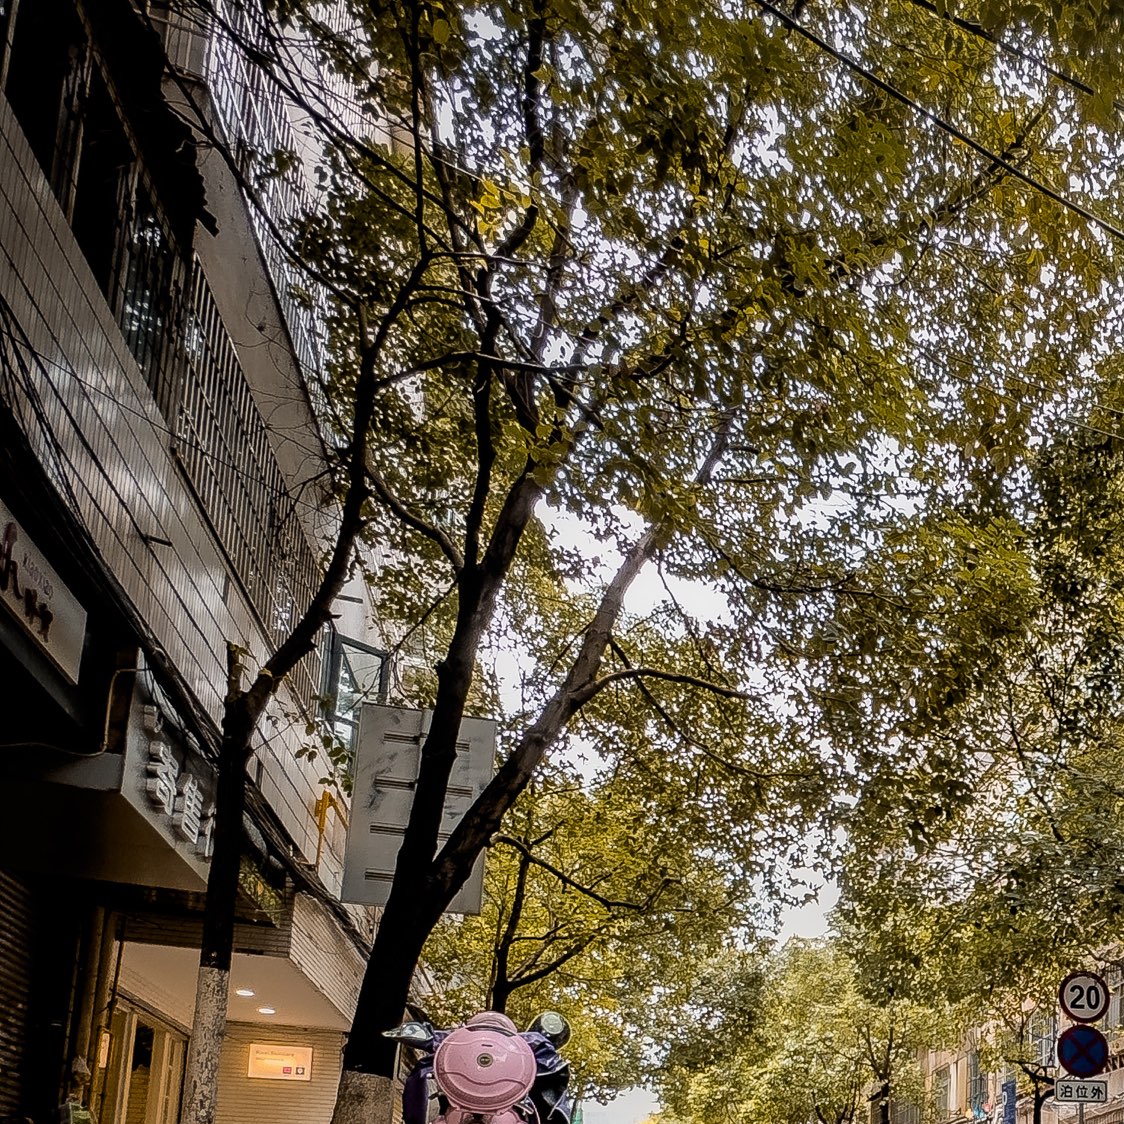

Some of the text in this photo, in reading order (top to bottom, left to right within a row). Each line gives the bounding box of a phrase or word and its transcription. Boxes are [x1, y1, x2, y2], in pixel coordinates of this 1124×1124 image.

[1069, 984, 1100, 1010] 20
[1060, 1084, 1104, 1099] 泊位外
